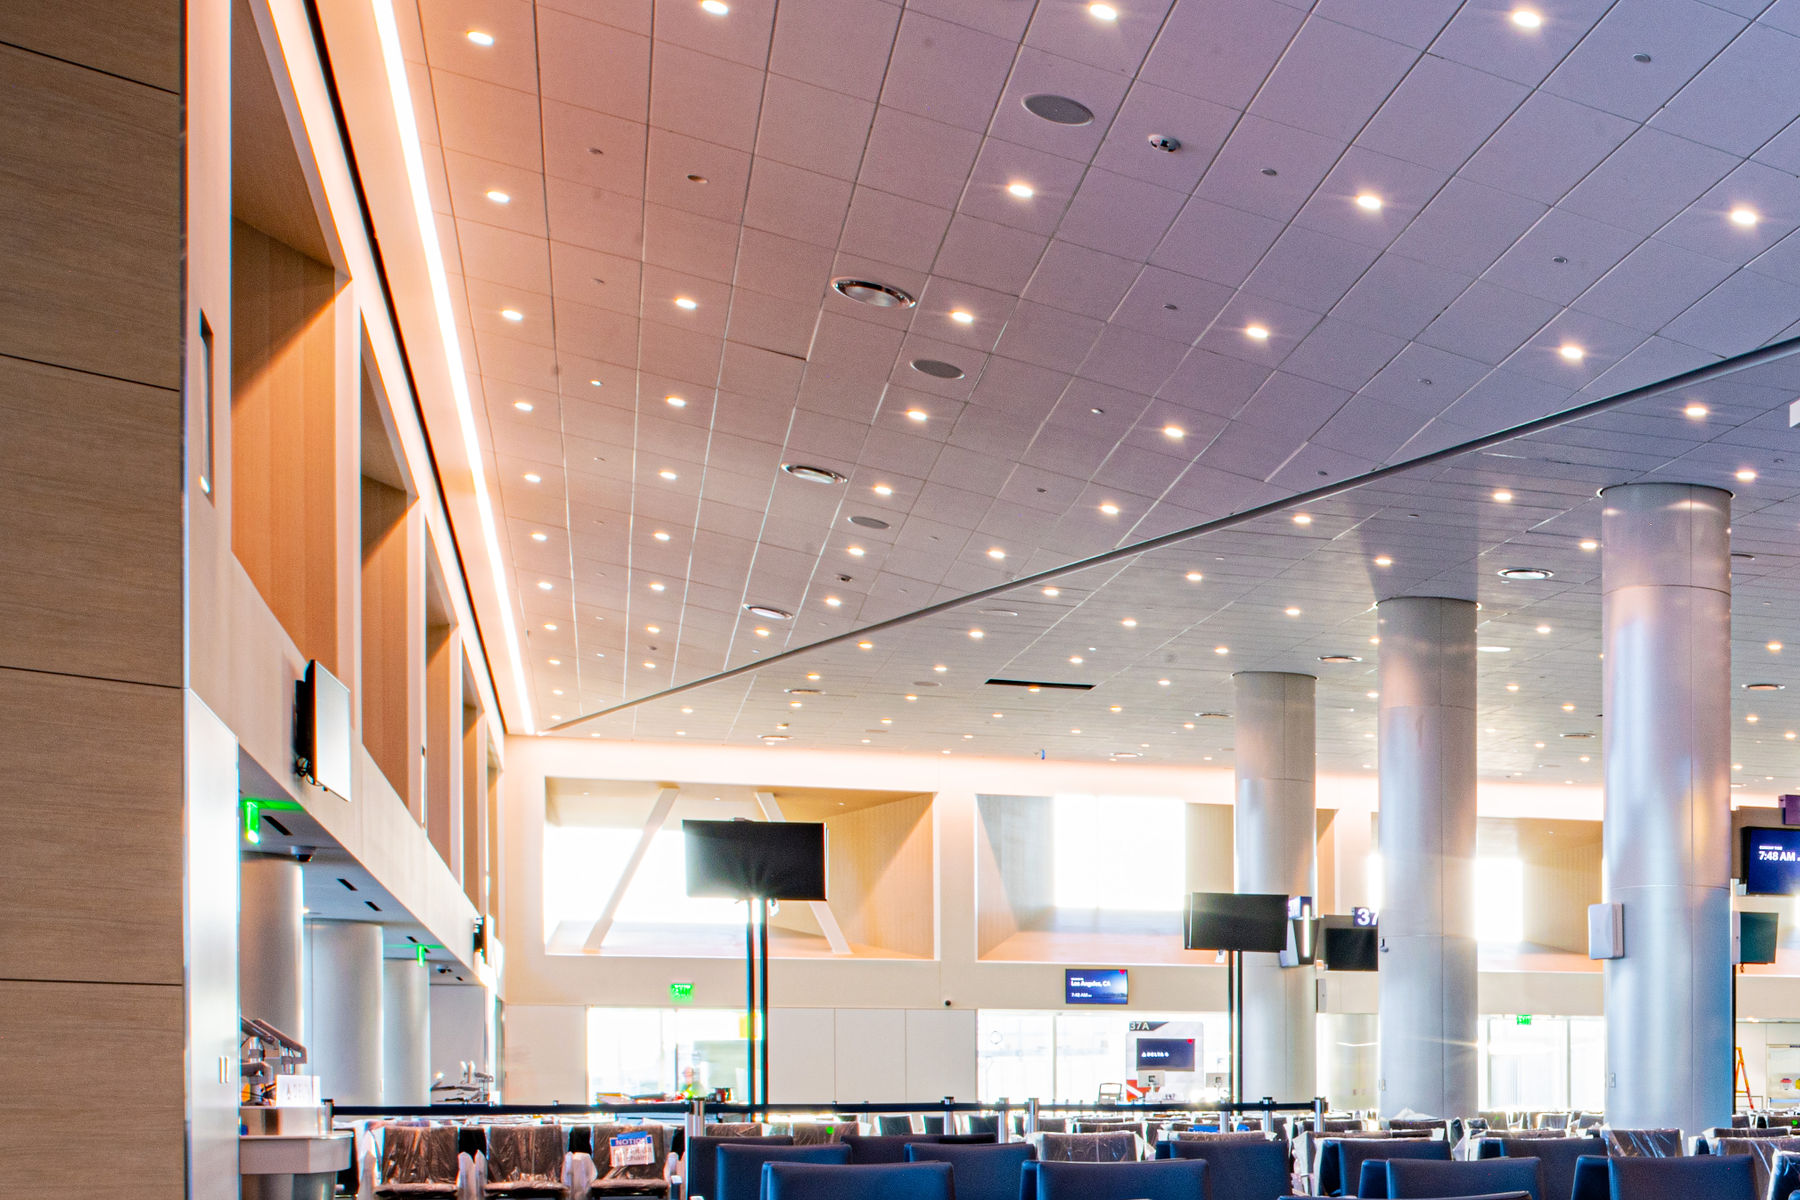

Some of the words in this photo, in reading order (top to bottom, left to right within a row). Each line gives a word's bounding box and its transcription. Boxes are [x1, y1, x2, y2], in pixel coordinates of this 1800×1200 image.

[1759, 851, 1779, 861] 7:48
[1780, 852, 1796, 862] AM
[1357, 908, 1379, 926] 37
[1130, 1021, 1150, 1031] 37A
